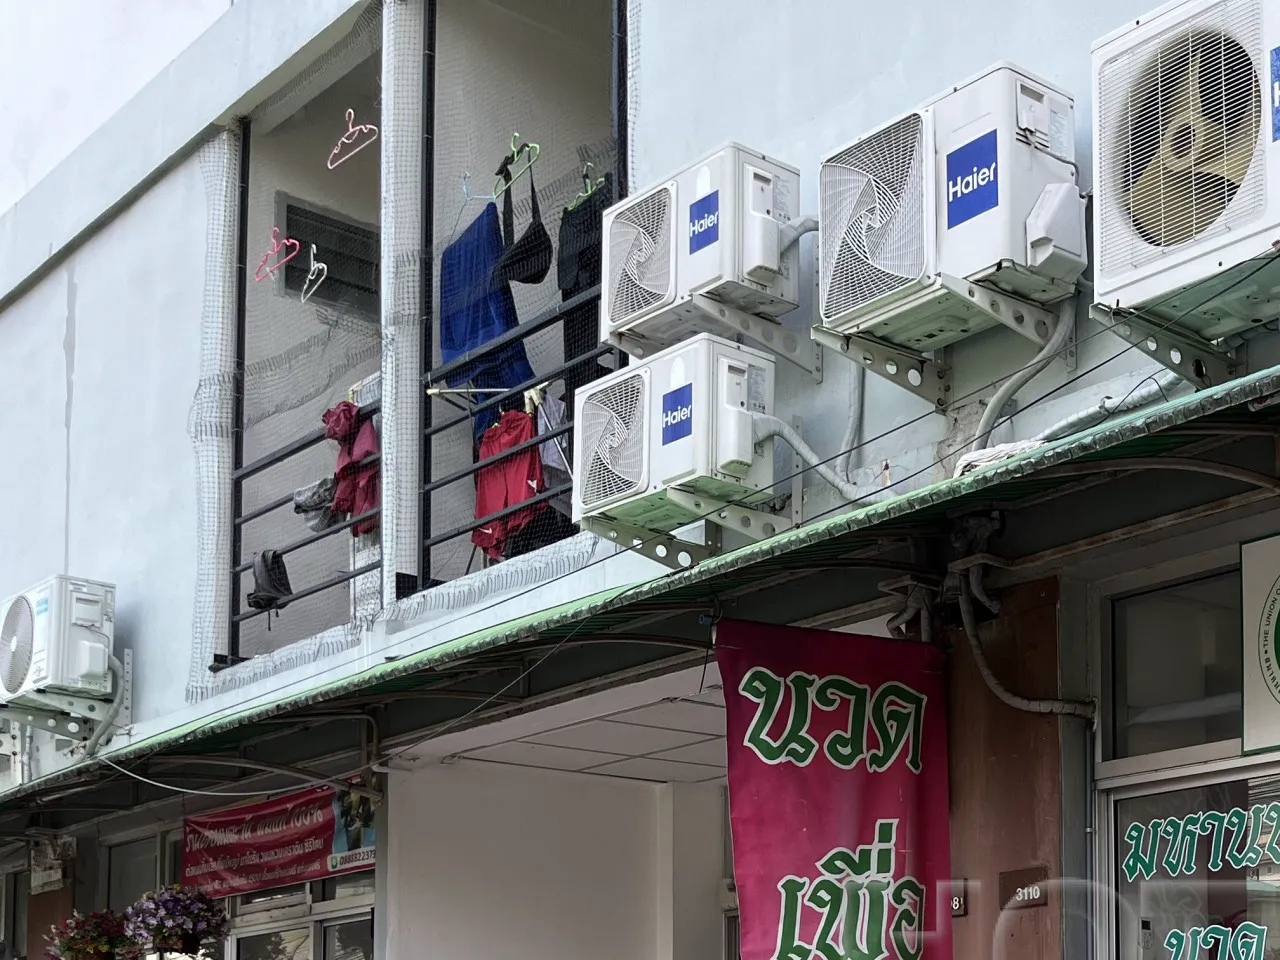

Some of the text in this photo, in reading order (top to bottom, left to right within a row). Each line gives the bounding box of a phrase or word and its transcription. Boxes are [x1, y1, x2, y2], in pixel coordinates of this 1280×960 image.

[948, 163, 996, 202] Haier
[689, 210, 719, 237] Haier
[662, 404, 692, 428] Haier
[1265, 596, 1278, 628] UNION
[738, 666, 928, 775] นวด
[1016, 886, 1041, 902] 3110
